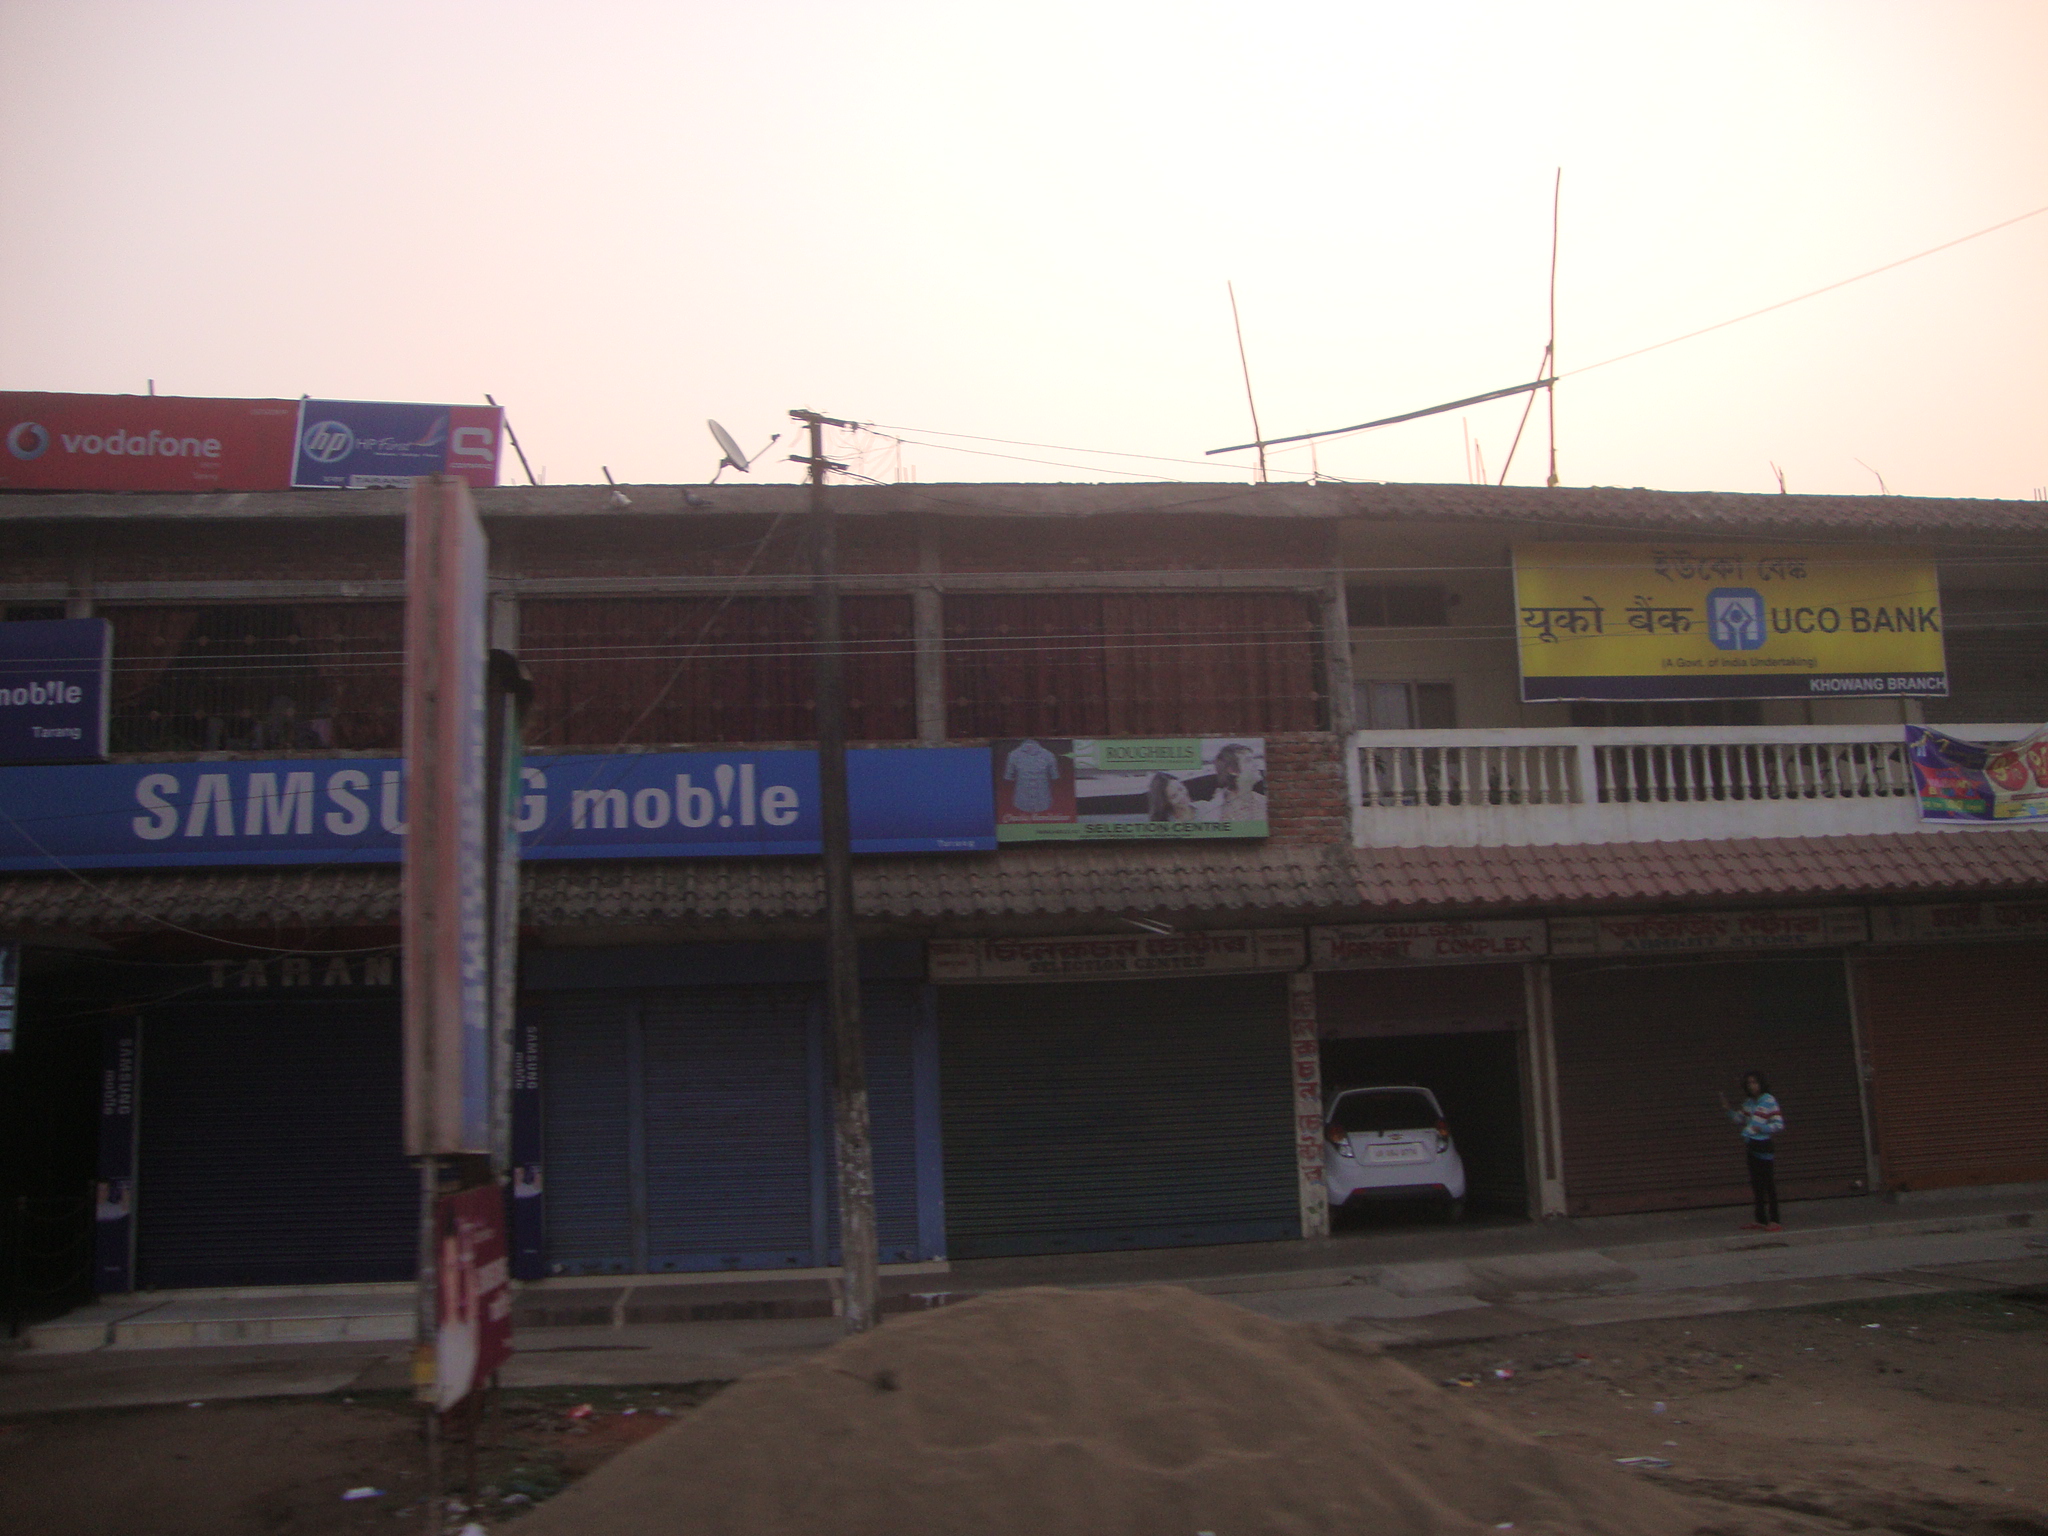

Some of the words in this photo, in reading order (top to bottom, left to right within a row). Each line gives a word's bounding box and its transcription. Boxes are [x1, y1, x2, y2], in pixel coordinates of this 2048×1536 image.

[61, 429, 222, 457] vodafone
[1521, 595, 1605, 644] यूको
[1625, 594, 1694, 634] बैंक
[1771, 607, 1840, 634] UCO
[1850, 606, 1941, 633] BANK
[1676, 657, 1704, 668] Govt.
[1708, 657, 1720, 668] of
[1722, 657, 1748, 668] India
[1750, 655, 1818, 669] Undertaking)
[1809, 678, 1884, 692] KHOWANG
[1887, 677, 1946, 690] BRANCH
[31, 726, 82, 741] Tarang
[1105, 746, 1195, 759] ROUGHELLS
[133, 767, 547, 840] SAMSUG
[1084, 822, 1169, 834] SELECTION
[1172, 821, 1232, 833] CENTRE
[1331, 939, 1412, 957] MARKET
[1436, 936, 1533, 955] COMPLEX
[525, 1025, 539, 1090] SAMSUNG
[117, 1037, 136, 1116] SAMSUNG
